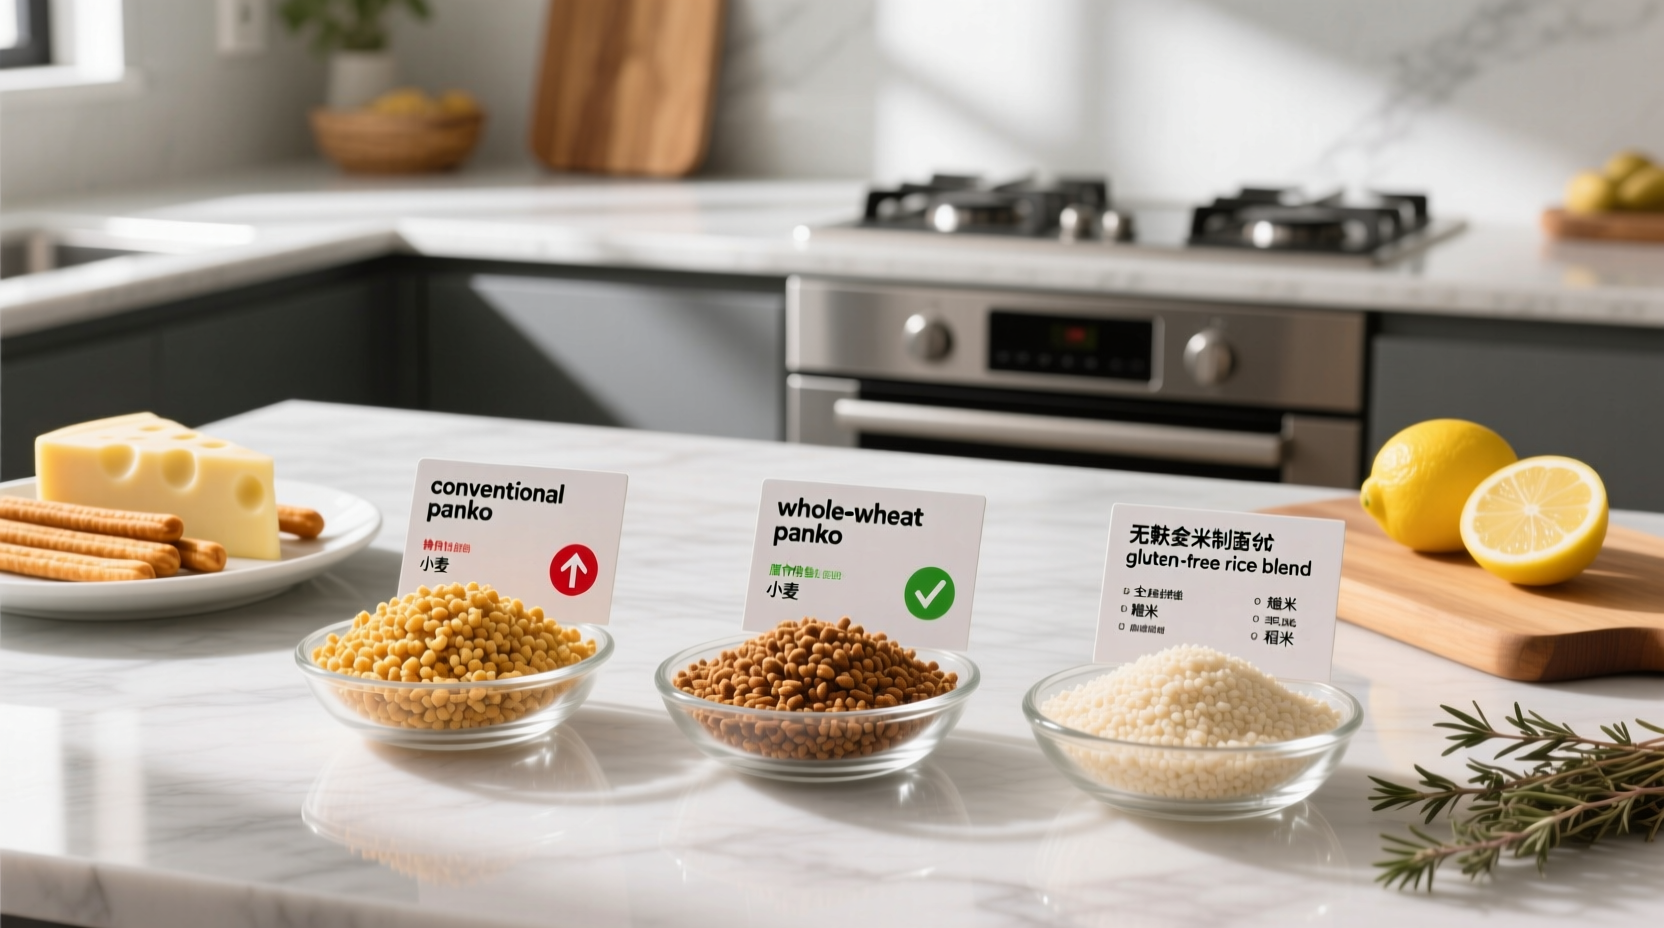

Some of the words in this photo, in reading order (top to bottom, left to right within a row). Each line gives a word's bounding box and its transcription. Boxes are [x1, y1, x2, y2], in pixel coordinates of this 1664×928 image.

[430, 480, 566, 504] conventional
[426, 499, 493, 522] panko
[777, 497, 924, 527] whole-wheat
[773, 523, 843, 546] panko
[419, 555, 450, 574] 小麦
[1126, 549, 1220, 571] gluten-free
[1225, 556, 1258, 573] rice
[1262, 558, 1312, 576] blend
[766, 580, 800, 600] 小麦
